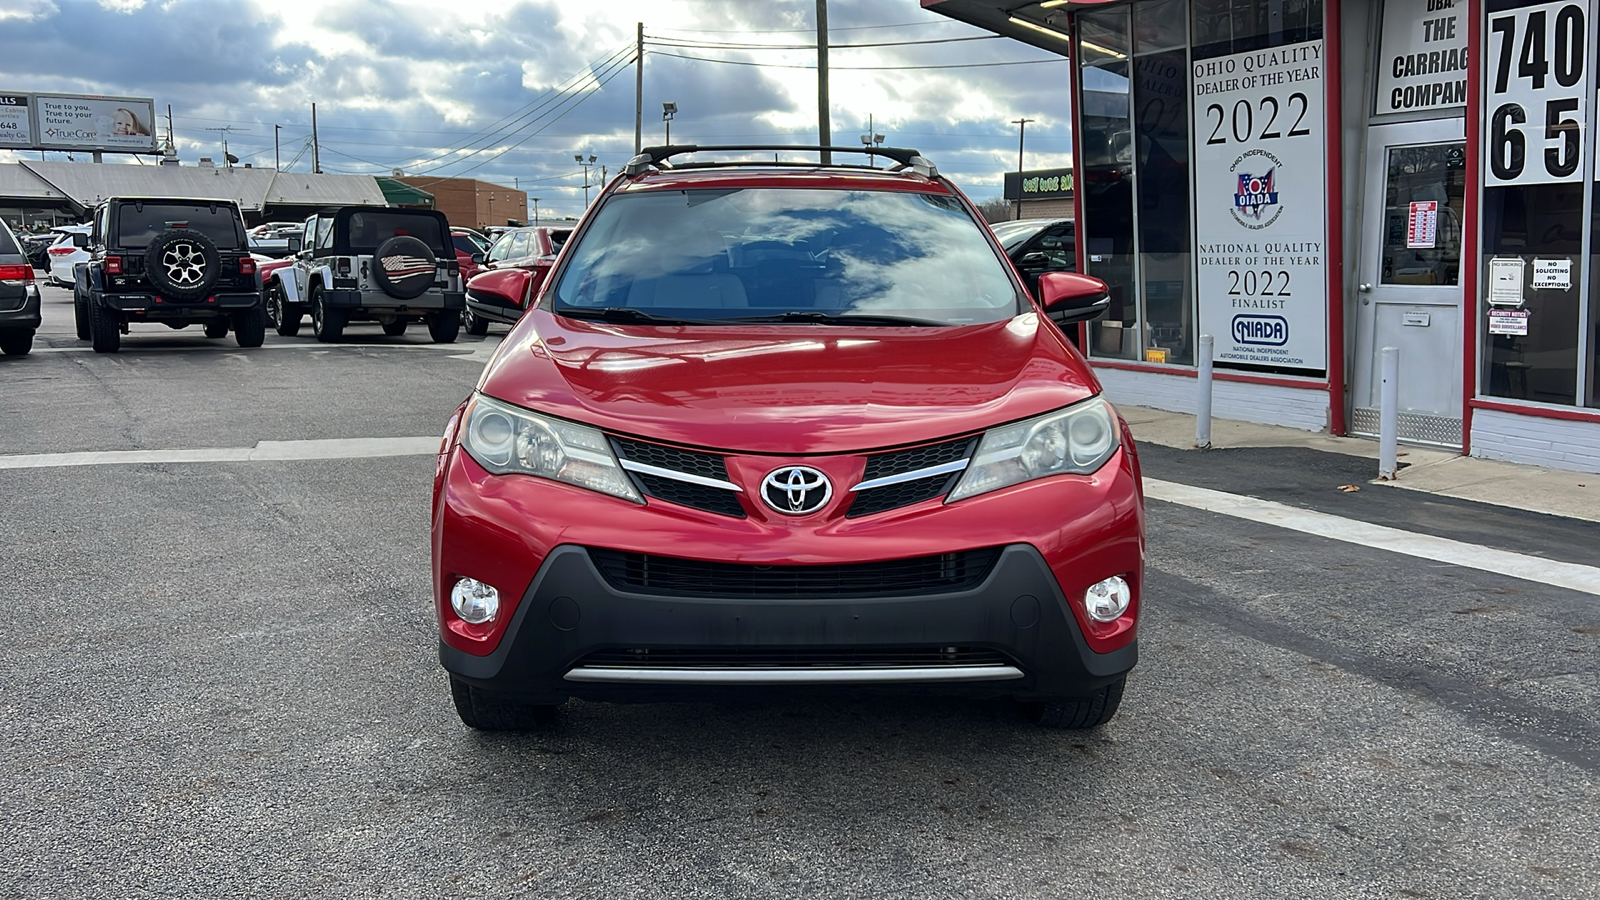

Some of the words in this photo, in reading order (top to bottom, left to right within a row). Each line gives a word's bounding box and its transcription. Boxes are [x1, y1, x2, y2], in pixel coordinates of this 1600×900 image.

[1423, 16, 1456, 43] THE
[1491, 5, 1585, 94] 740
[1194, 58, 1236, 79] OHIO
[1243, 44, 1322, 73] QUALITY
[1196, 79, 1240, 96] DEALER
[1242, 75, 1258, 90] OF
[1259, 72, 1284, 88] THE
[1286, 66, 1320, 85] YEAR
[1206, 92, 1310, 146] 2022
[54, 128, 97, 138] TrueCore
[1229, 156, 1243, 173] OHIO
[1243, 149, 1284, 169] INDEPENDENT
[1239, 193, 1271, 206] OIADA
[1200, 243, 1260, 254] NATIONAL
[1265, 242, 1322, 254] QUALITY
[1201, 256, 1241, 266] DEALER
[1245, 256, 1259, 266] OF
[1263, 256, 1285, 266] THE
[1289, 256, 1320, 266] YEAR
[1227, 270, 1292, 297] 2022
[1232, 298, 1286, 309] FINALIST
[1236, 320, 1283, 341] NIADA
[1219, 353, 1249, 361] AUTOMOBILE
[1249, 354, 1270, 362] DEALERS
[1270, 356, 1304, 364] ASSOCIATION
[1256, 347, 1289, 355] INDEPENDENT
